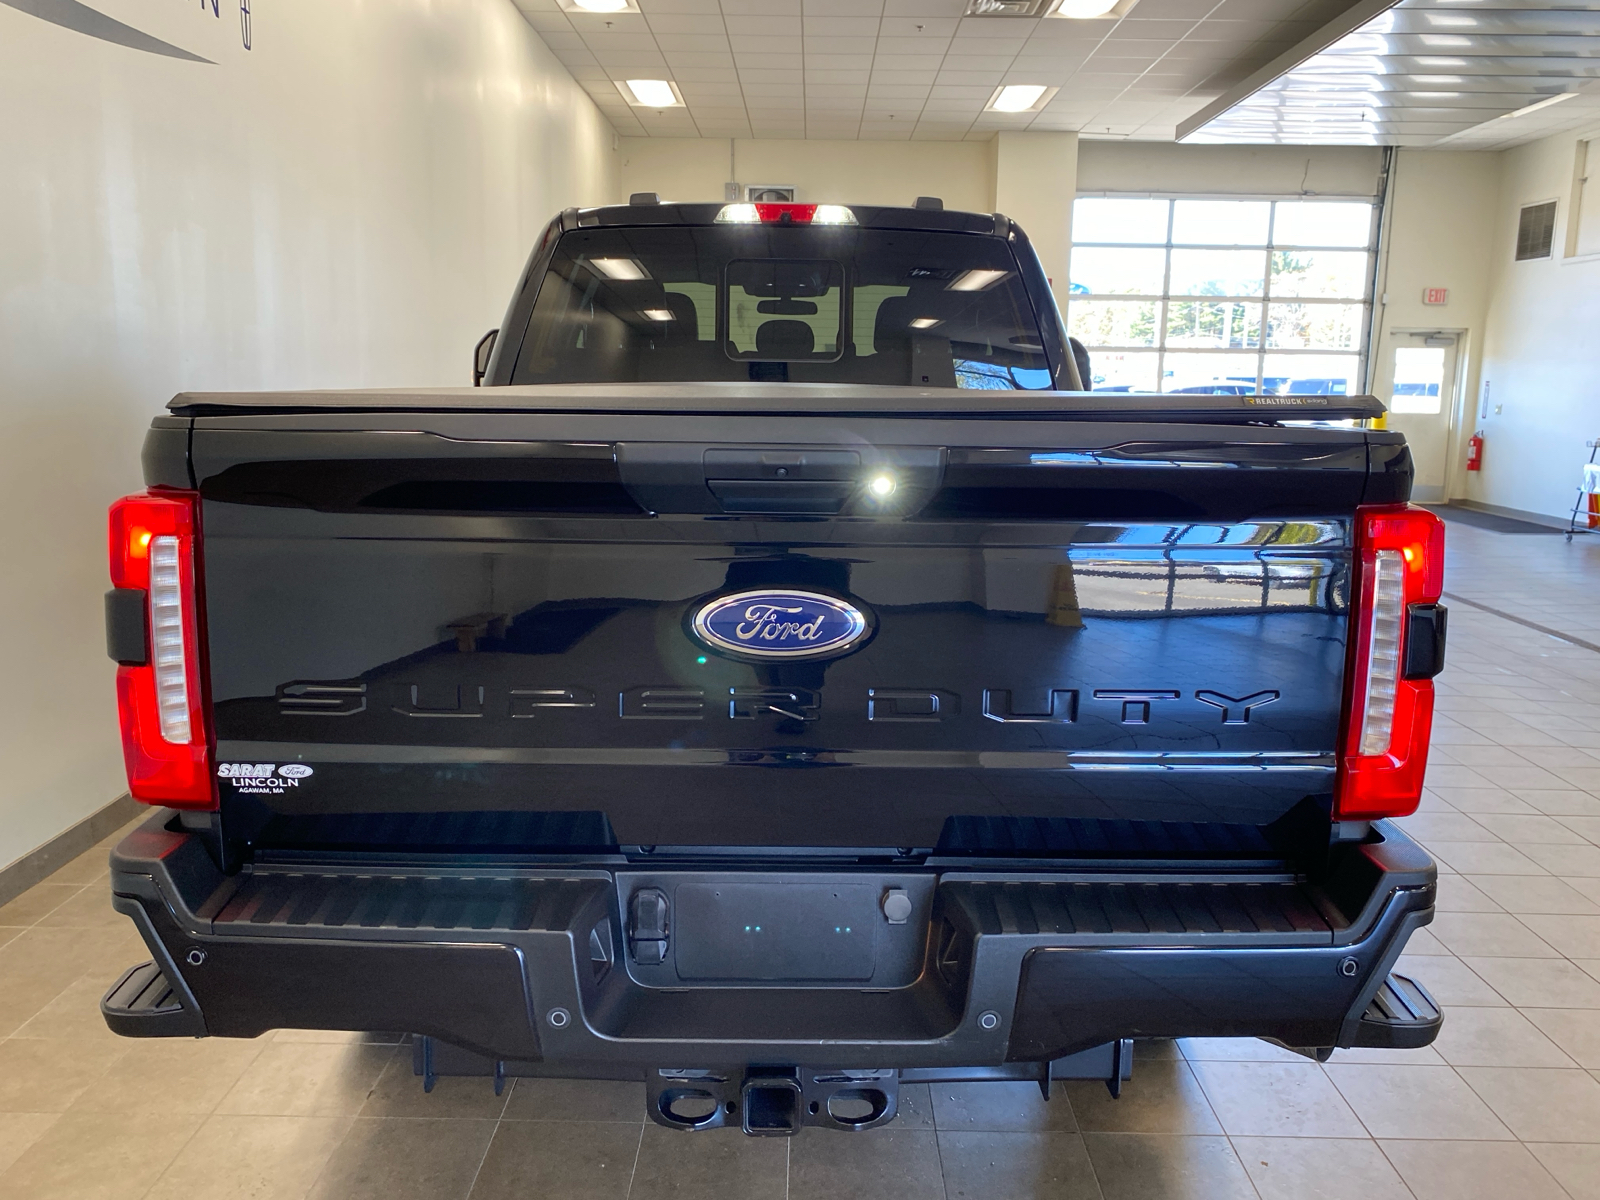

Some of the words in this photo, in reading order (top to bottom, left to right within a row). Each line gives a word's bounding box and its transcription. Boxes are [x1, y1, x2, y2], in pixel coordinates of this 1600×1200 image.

[1428, 288, 1447, 303] EXIT
[1255, 397, 1303, 405] REALTRUCK
[736, 604, 825, 640] Ford
[275, 680, 821, 723] SUPER
[867, 688, 1281, 725] DUTY
[218, 763, 275, 777] SARAT
[232, 778, 299, 787] LINCOLN
